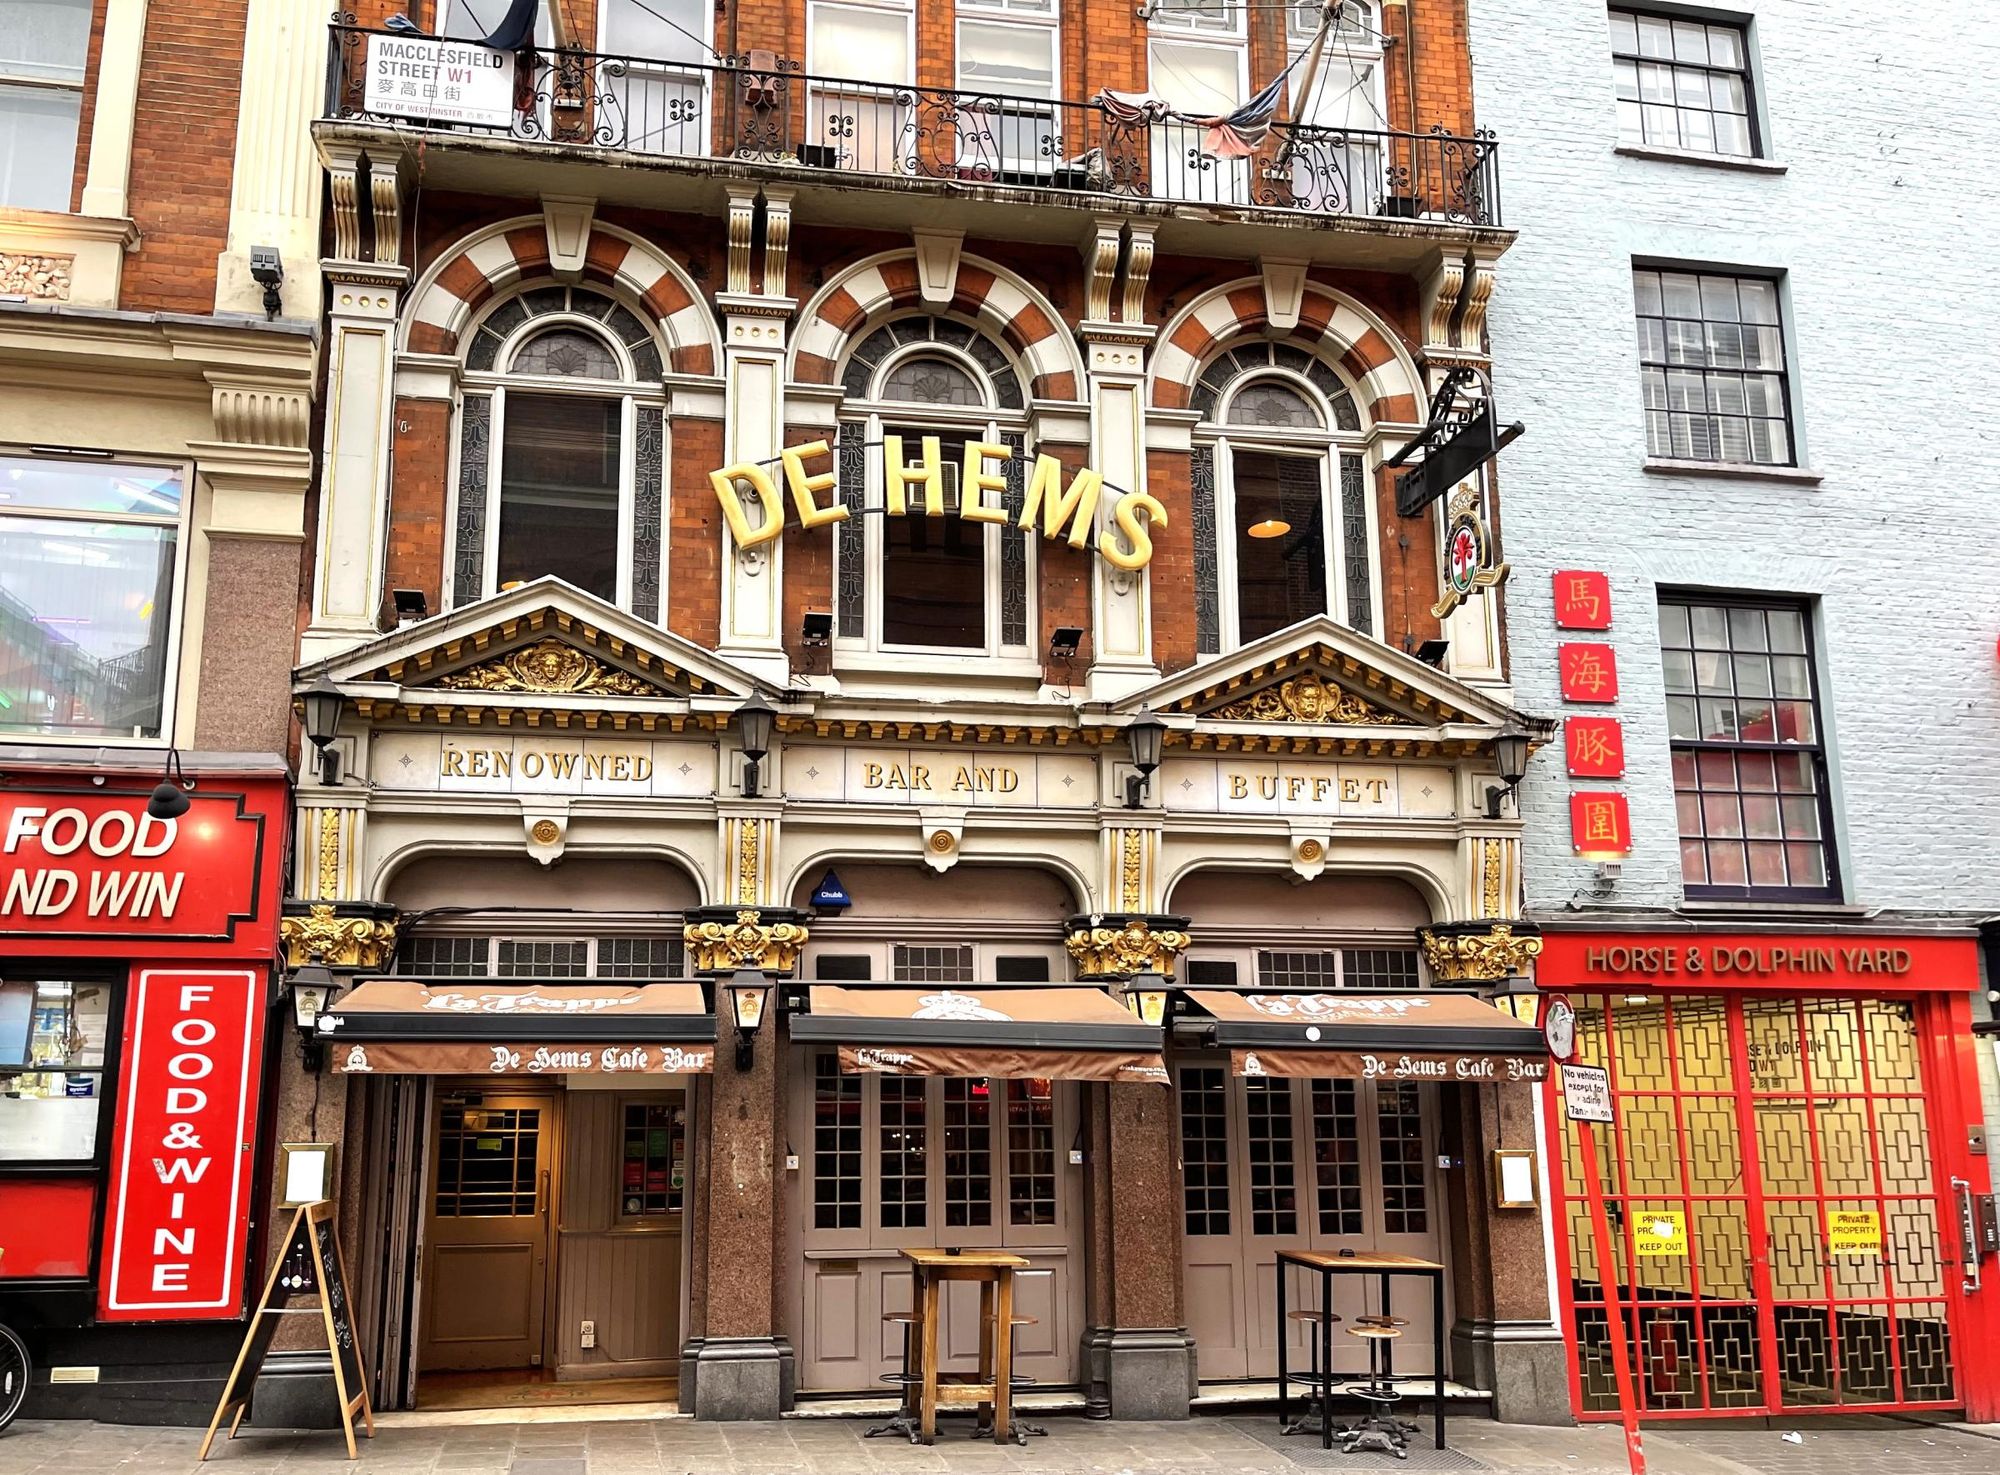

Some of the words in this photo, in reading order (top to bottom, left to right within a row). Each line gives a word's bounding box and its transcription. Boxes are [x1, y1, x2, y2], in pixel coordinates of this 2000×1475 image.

[379, 42, 504, 69] MACCLESFIELD
[378, 60, 441, 80] STREET
[448, 67, 473, 84] W1
[378, 78, 461, 102] 麥高田街
[376, 101, 393, 110] CITY
[395, 103, 405, 112] OF
[407, 105, 463, 117] WESTMINSTER
[708, 439, 850, 550] DE
[883, 435, 1169, 571] HEMS
[441, 750, 653, 782] RENOWNED
[864, 762, 930, 791] BAR
[951, 765, 1019, 793] AND
[1228, 774, 1388, 803] BUFFET
[3, 807, 178, 857] FOOD
[87, 871, 185, 918] WIN
[1587, 946, 1679, 972] HORSE
[1685, 947, 1705, 972] &
[1712, 946, 1836, 973] DOLPHIN
[1839, 948, 1912, 973] YARD
[165, 985, 216, 1114] FOOD
[489, 1046, 521, 1073] De
[527, 1046, 593, 1073] Hems
[601, 1047, 648, 1073] Cafe
[660, 1047, 707, 1073] Bar
[870, 1048, 914, 1065] Trappe
[1360, 1054, 1387, 1079] De
[1393, 1055, 1447, 1079] Hems
[1455, 1057, 1494, 1080] Cafe
[1504, 1058, 1545, 1081] Bar
[1564, 1068, 1575, 1078] No
[1594, 1084, 1604, 1093] for
[151, 1157, 212, 1292] WINE
[1642, 1215, 1675, 1224] PRIVATE
[1832, 1226, 1876, 1234] PROPERTY
[1837, 1215, 1870, 1224] PRIVATE
[1639, 1242, 1662, 1251] KEEP
[1665, 1242, 1682, 1251] OUT
[1834, 1242, 1857, 1250] KEEP
[1860, 1242, 1877, 1250] OUT
